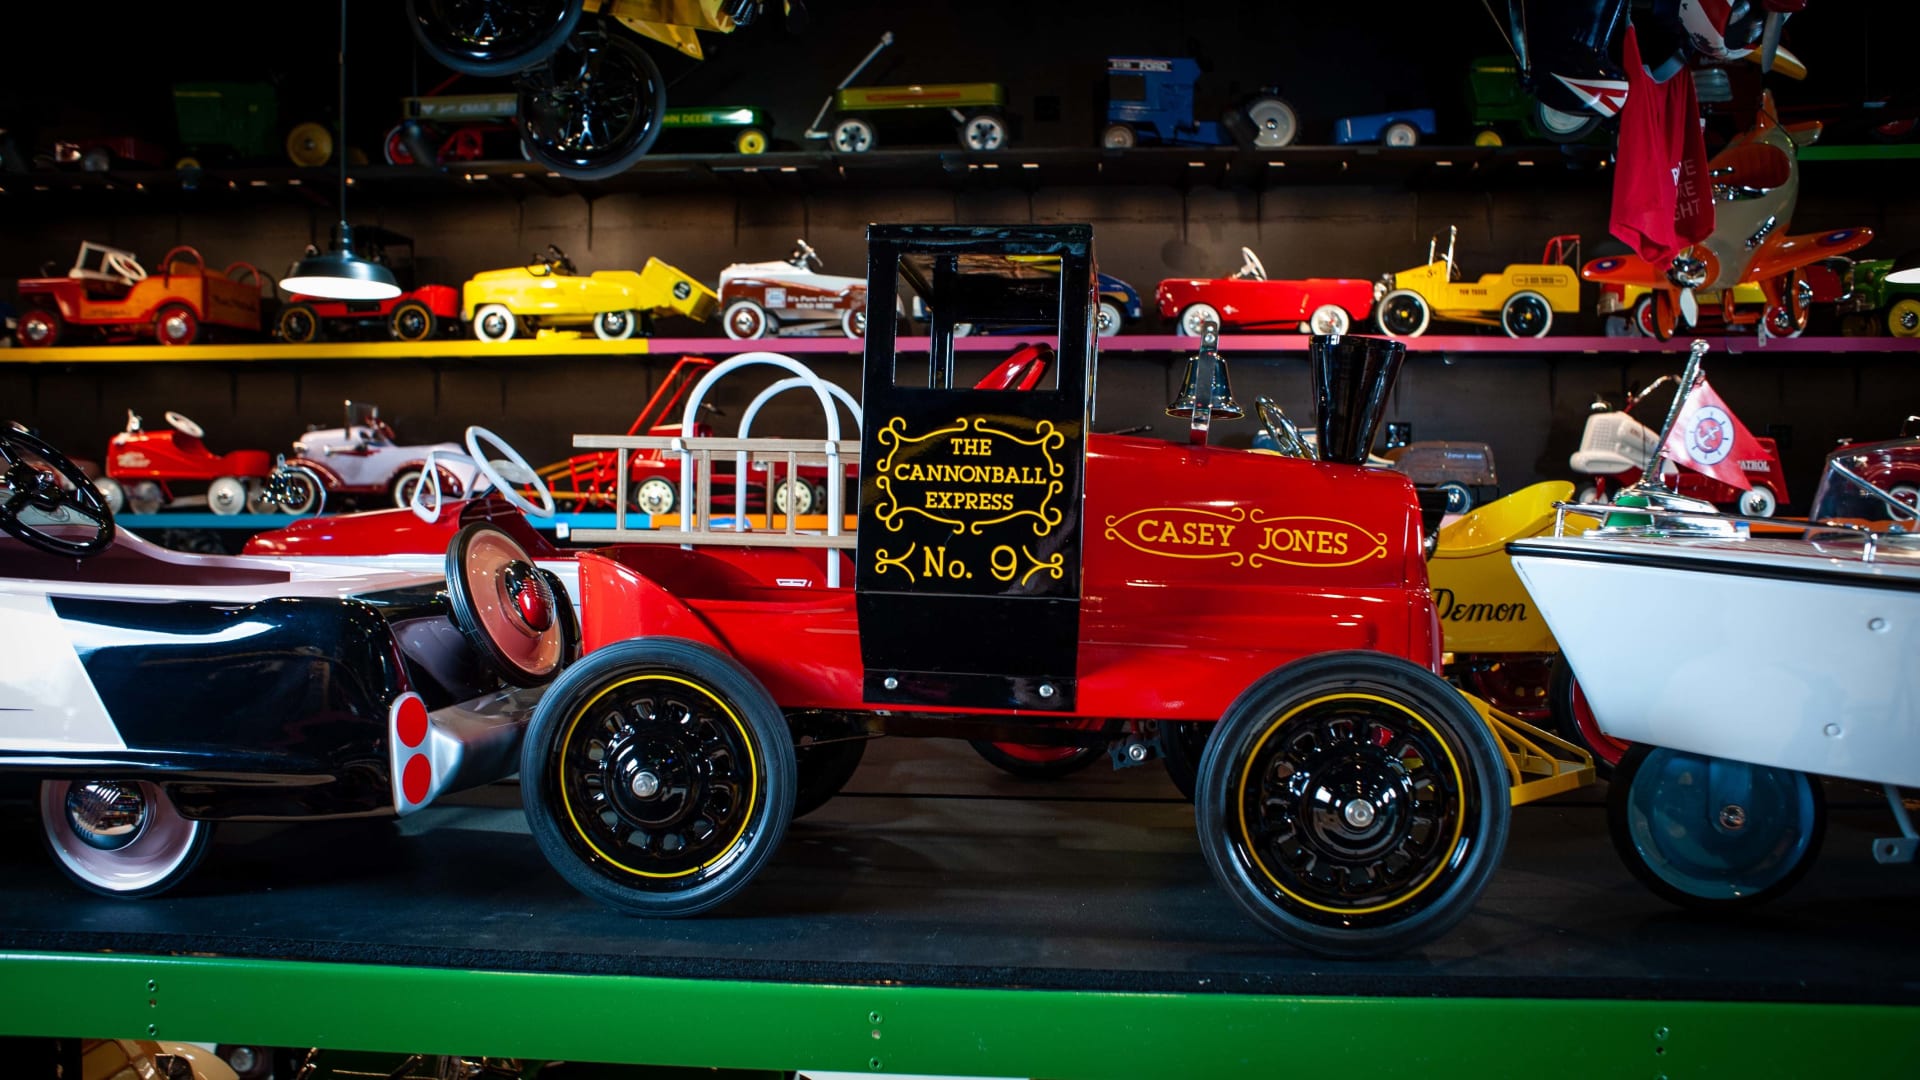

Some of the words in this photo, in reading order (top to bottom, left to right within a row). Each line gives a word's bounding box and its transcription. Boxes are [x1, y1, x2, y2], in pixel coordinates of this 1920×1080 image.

[951, 438, 992, 456] THE
[894, 463, 1047, 485] CANNONBALL
[1737, 459, 1771, 472] ATROL
[925, 491, 1014, 511] EXPRESS
[1137, 519, 1236, 547] CASEY
[1257, 527, 1348, 555] JONES
[923, 546, 973, 579] No.
[990, 544, 1018, 581] 9
[1433, 588, 1527, 622] Demon
